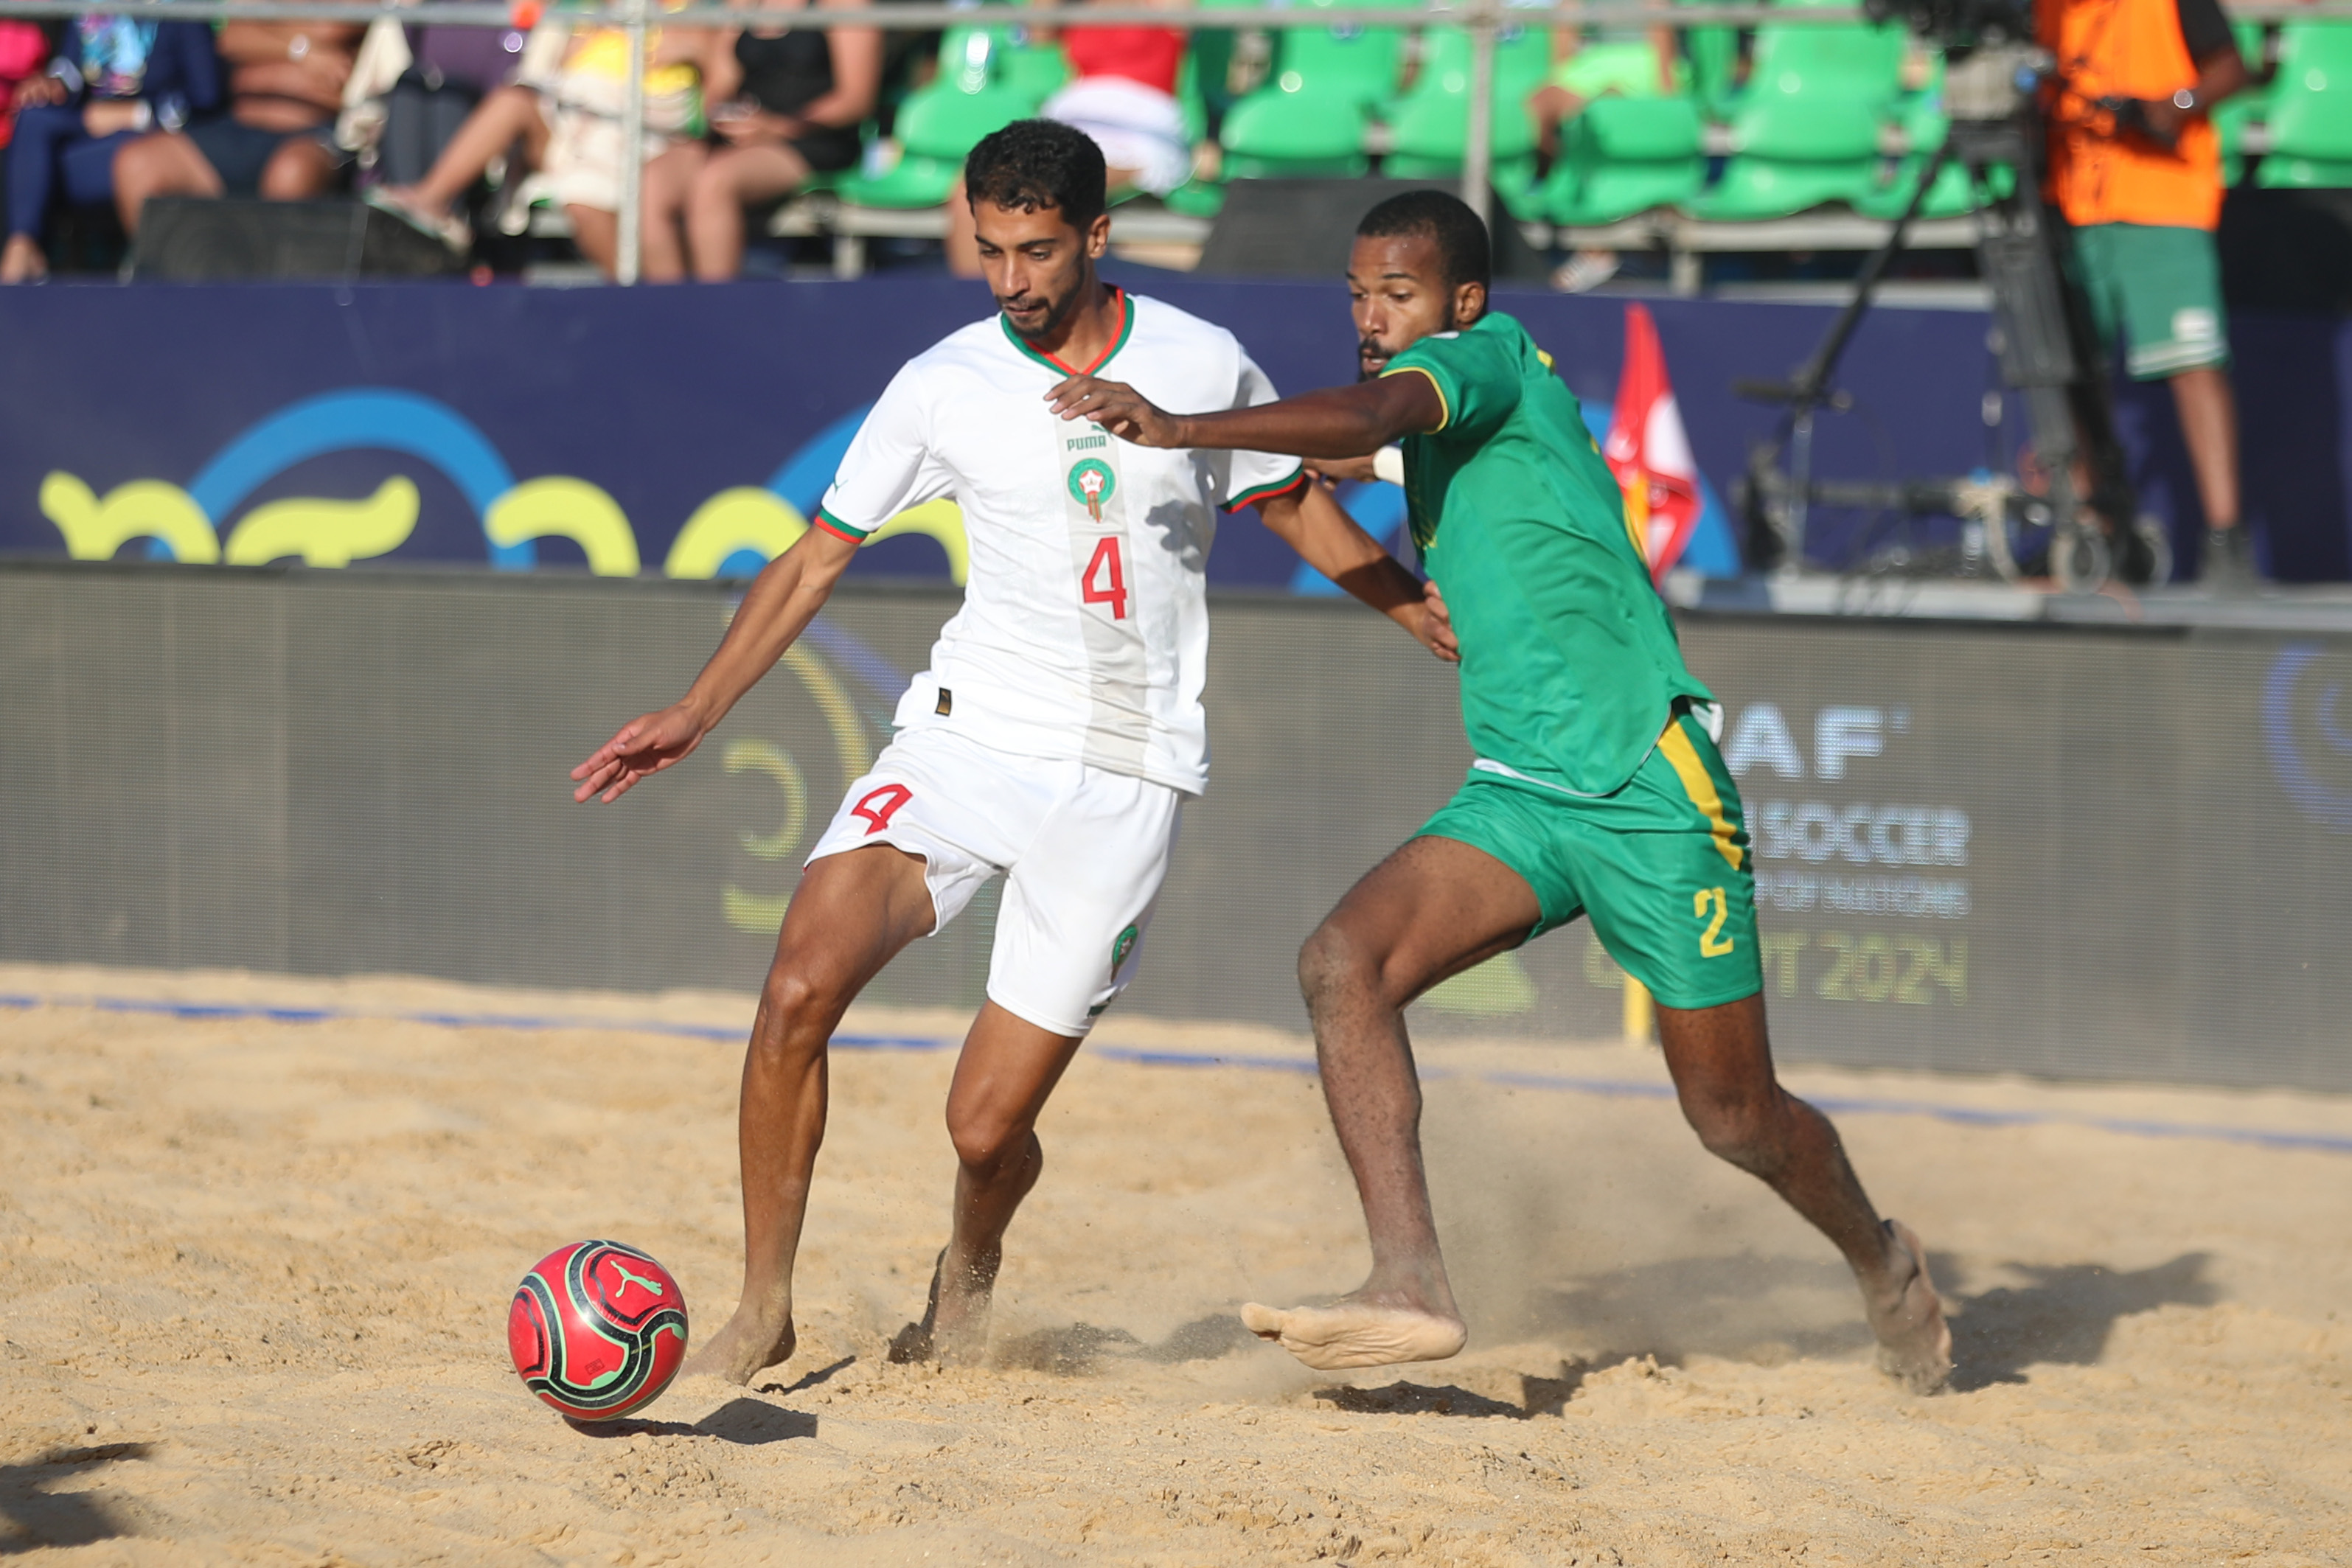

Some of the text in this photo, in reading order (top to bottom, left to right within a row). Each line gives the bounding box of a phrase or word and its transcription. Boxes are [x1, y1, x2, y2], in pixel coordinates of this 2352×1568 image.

[1067, 435, 1106, 451] PUMA
[1081, 536, 1127, 620] 4
[1722, 703, 1886, 781] AF
[849, 783, 914, 837] 4
[1694, 886, 1734, 958] 2
[1815, 930, 1969, 1006] 2024
